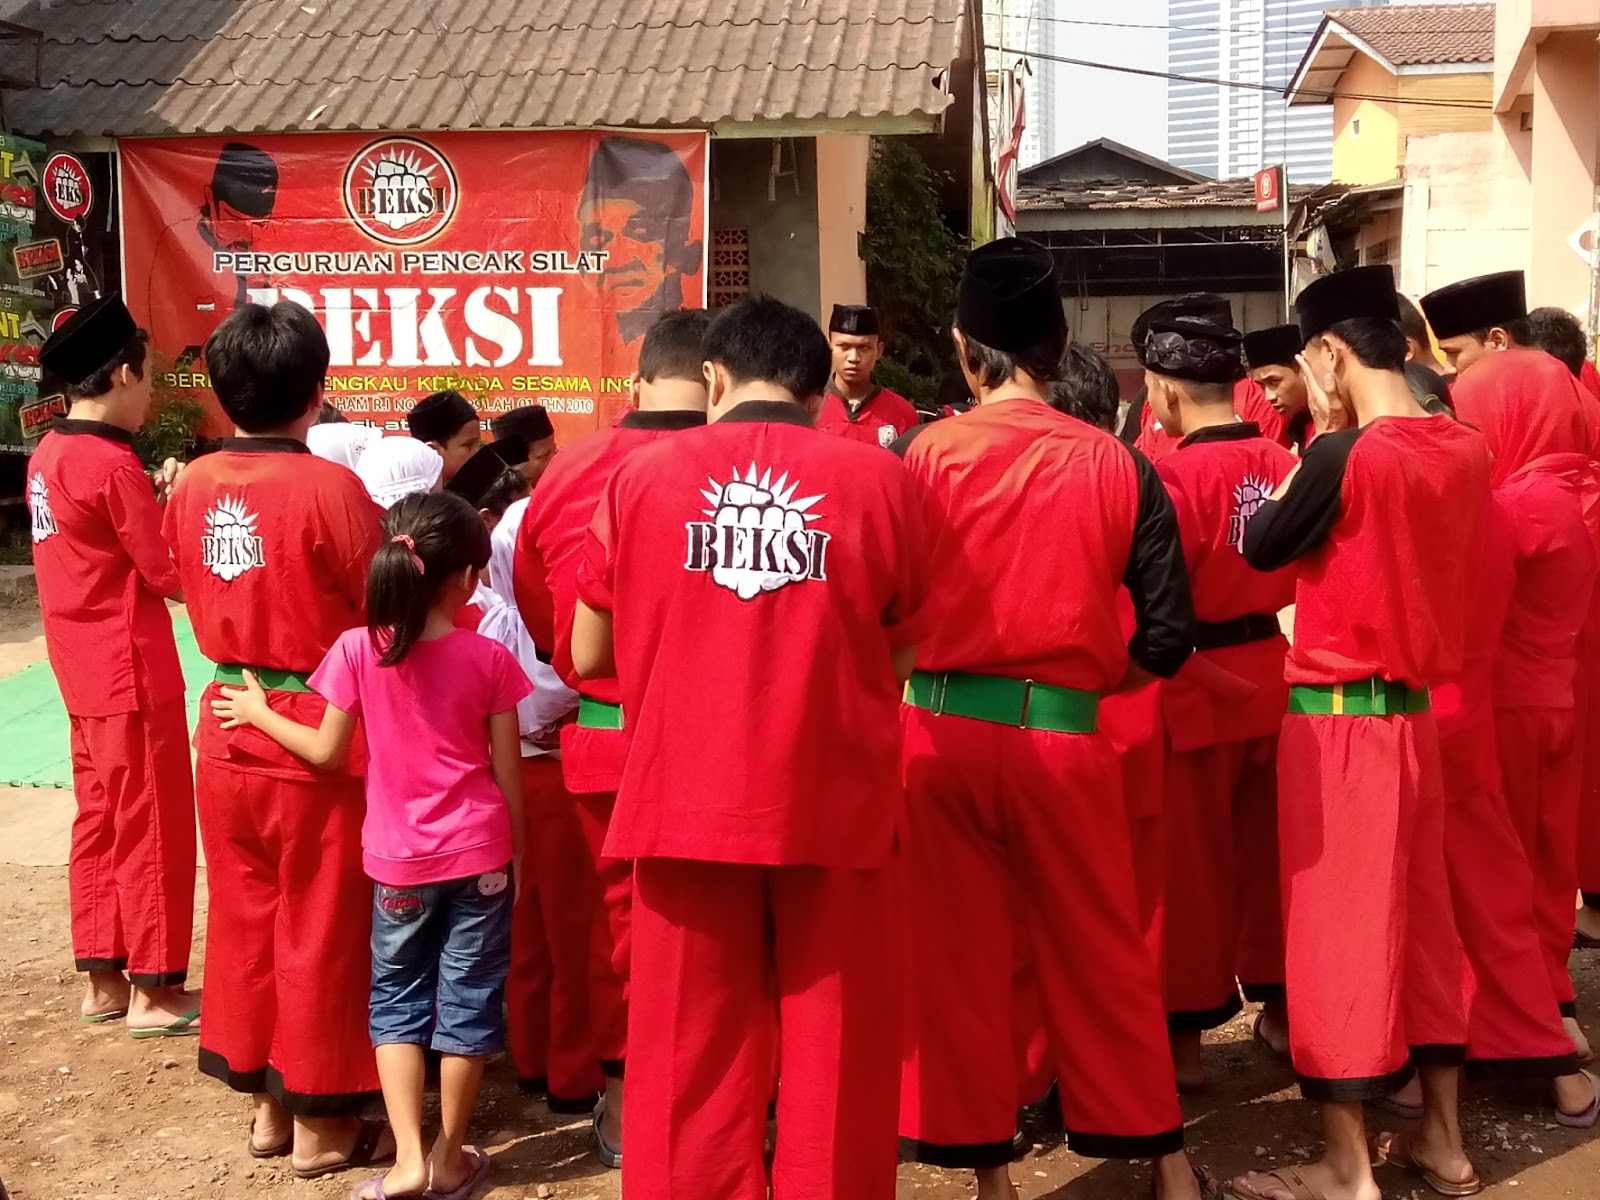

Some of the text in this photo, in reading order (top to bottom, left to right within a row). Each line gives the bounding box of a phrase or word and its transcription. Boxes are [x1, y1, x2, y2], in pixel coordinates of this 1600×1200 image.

[356, 187, 446, 215] BEKSI
[213, 250, 608, 274] PERGURUAN PENCAK SILAT
[247, 286, 564, 367] EKSI
[323, 375, 408, 391] ENGKAU
[416, 375, 504, 392] KEPADA
[511, 375, 593, 392] SESAMA
[334, 397, 369, 412] HAM
[566, 397, 594, 413] 2010
[201, 536, 264, 566] BEKSI
[685, 521, 831, 581] BEKSI
